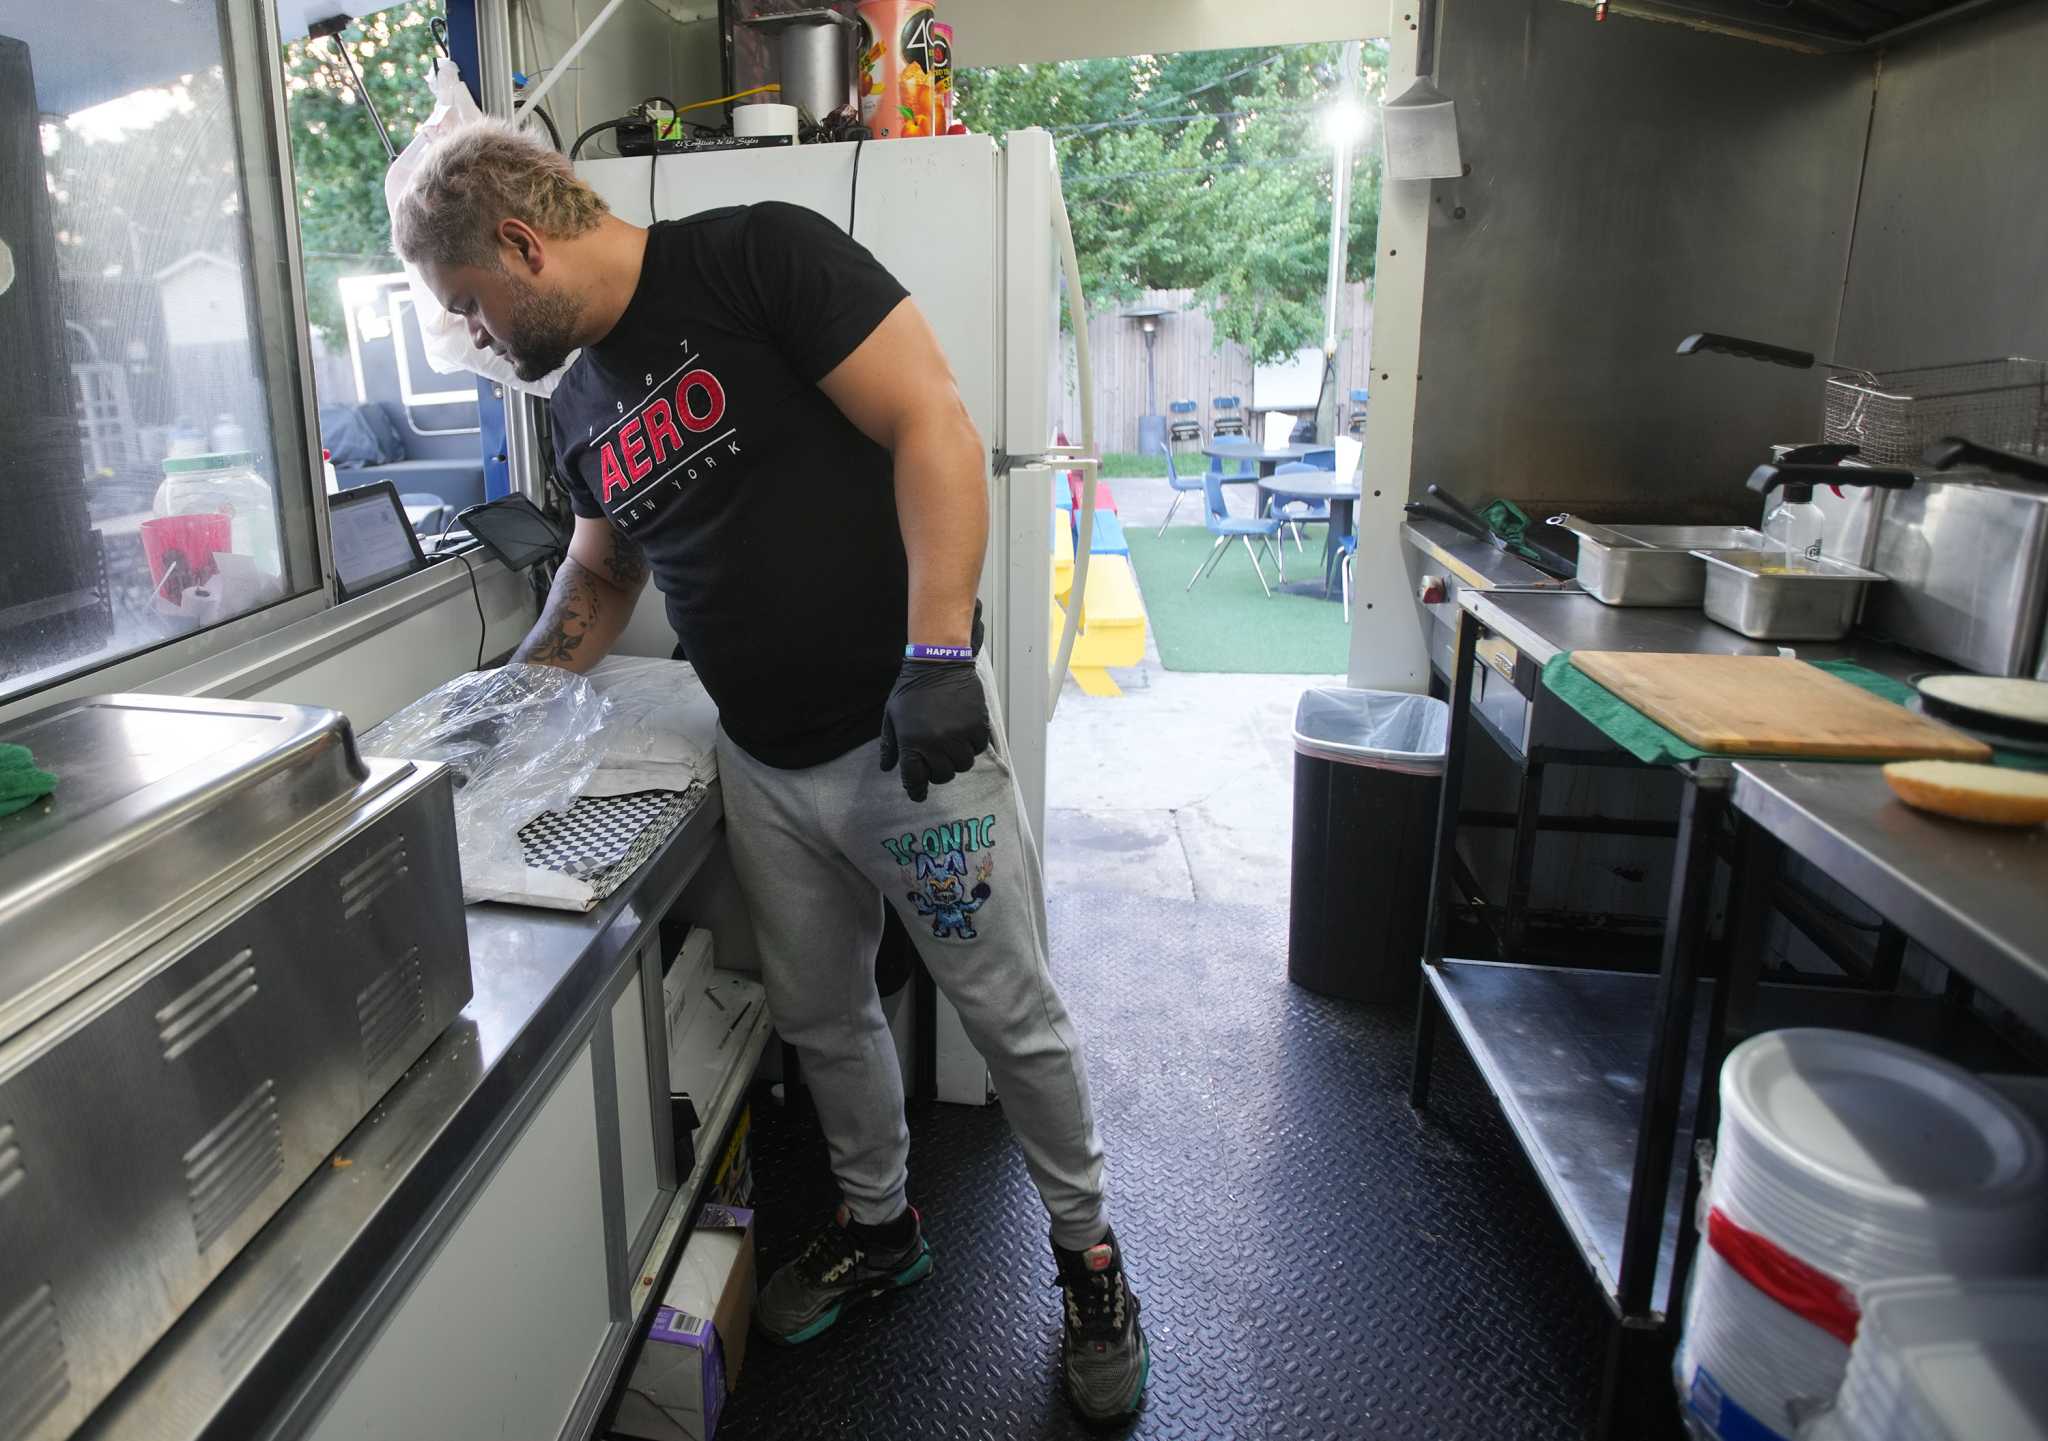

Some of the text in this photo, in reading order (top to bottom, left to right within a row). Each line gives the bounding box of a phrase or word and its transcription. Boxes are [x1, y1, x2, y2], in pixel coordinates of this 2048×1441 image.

[736, 137, 759, 146] Siglos
[600, 368, 726, 503] AERO
[618, 440, 741, 527] NEW YORK
[926, 647, 958, 657] HAPPY
[881, 814, 996, 866] ICONIC
